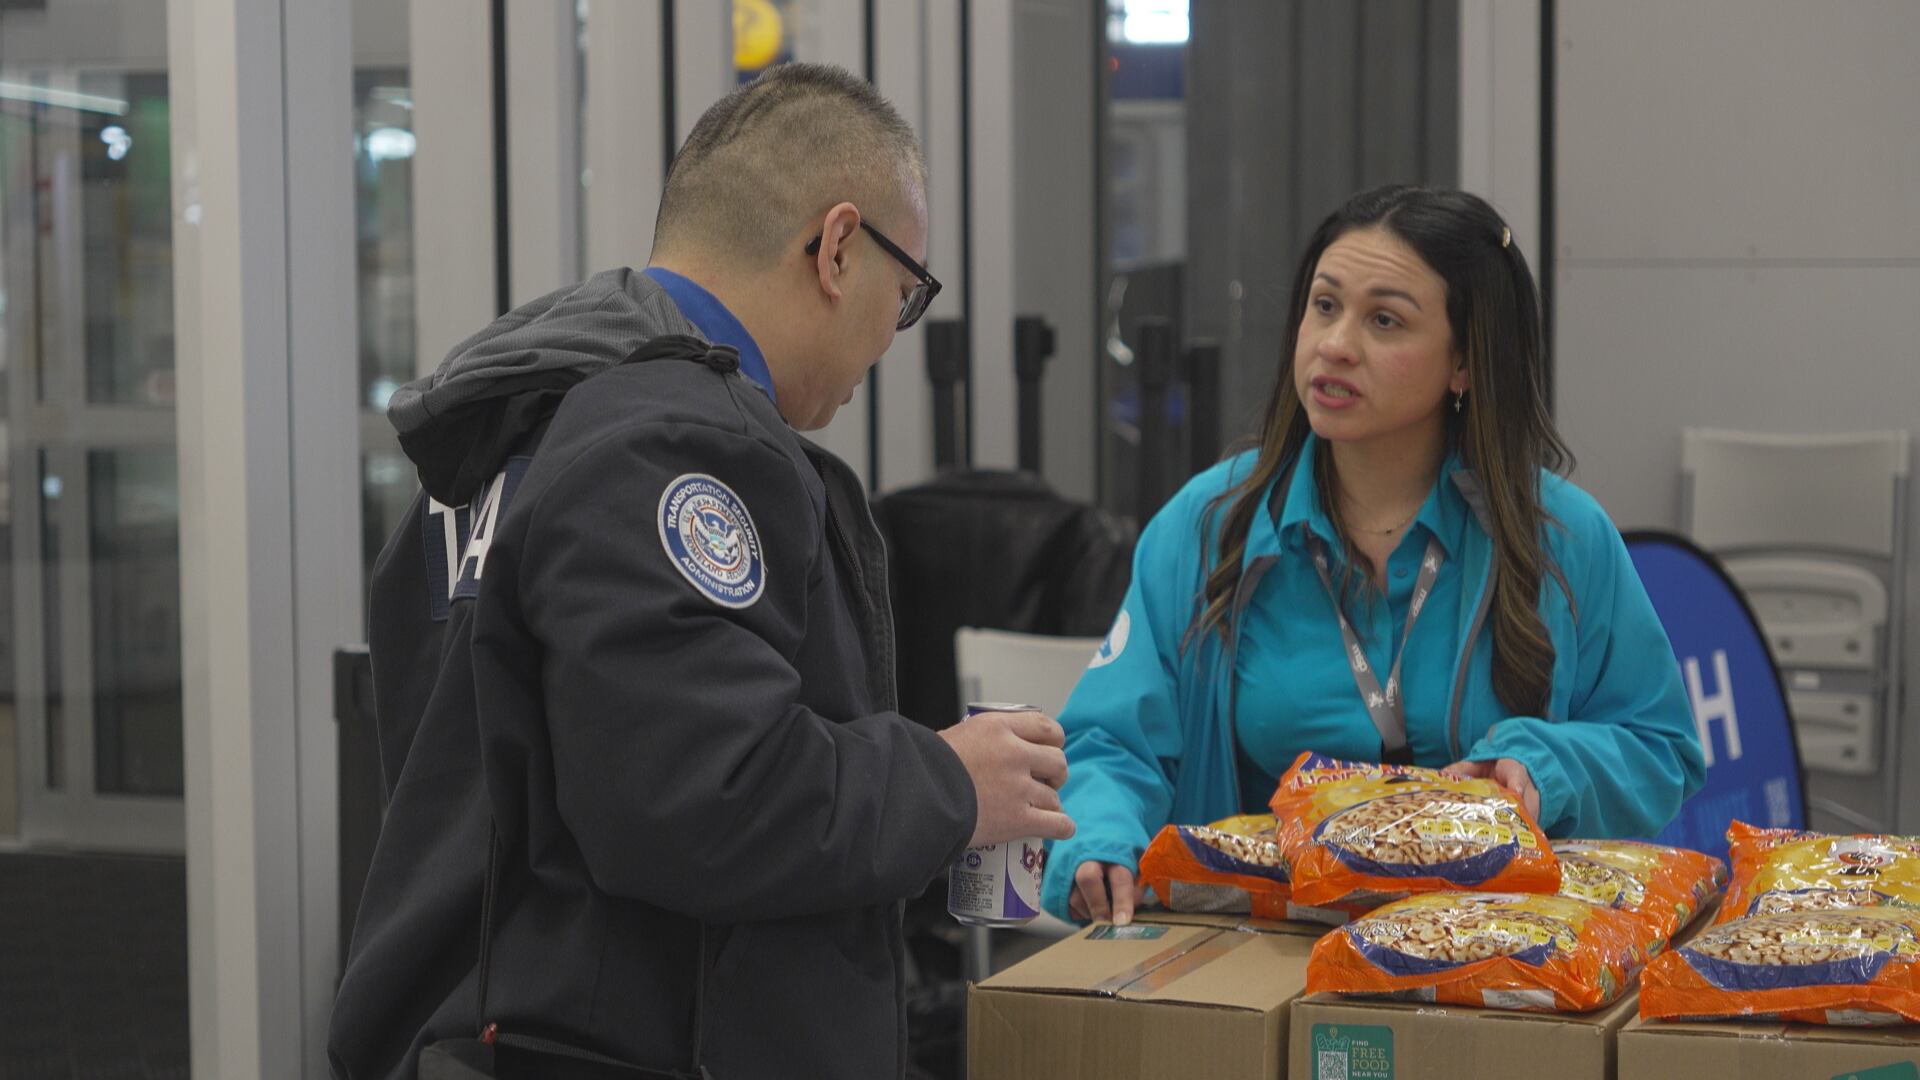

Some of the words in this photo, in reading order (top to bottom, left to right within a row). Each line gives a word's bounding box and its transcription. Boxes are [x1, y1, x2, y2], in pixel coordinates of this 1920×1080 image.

[429, 472, 506, 599] TA
[667, 483, 730, 529] TRANSPORTATION
[730, 504, 759, 560] SECURITY
[681, 557, 756, 597] ADMINISTRATION
[1352, 1048, 1386, 1059] FREE
[1352, 1059, 1390, 1071] FOOD
